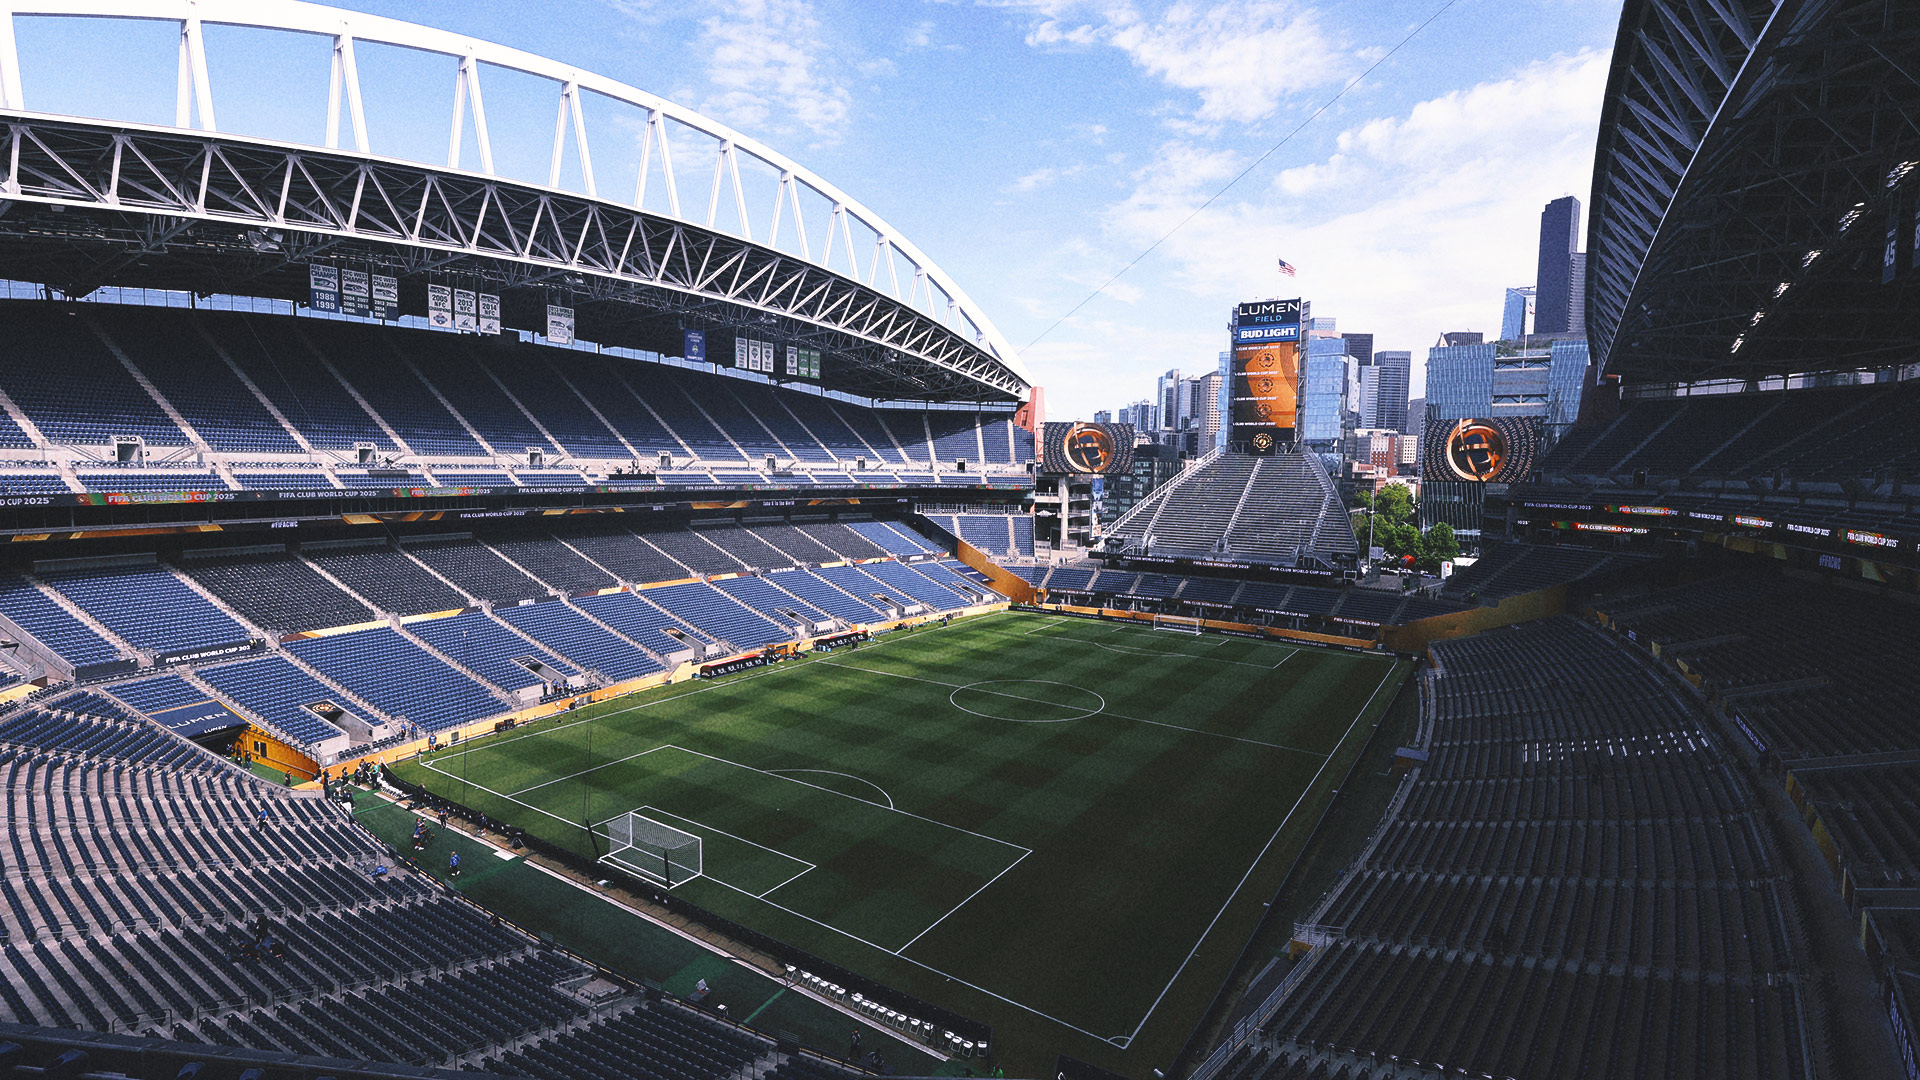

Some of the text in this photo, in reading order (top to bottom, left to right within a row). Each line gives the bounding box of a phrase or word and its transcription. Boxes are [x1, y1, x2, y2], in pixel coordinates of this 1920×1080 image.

[1884, 240, 1896, 266] 45
[310, 270, 337, 280] CHAMPS
[343, 276, 368, 285] CHAMPS
[374, 281, 396, 289] CHAMPS
[315, 292, 335, 301] 1988
[432, 294, 447, 302] 2005
[316, 300, 335, 310] 1999
[1239, 302, 1300, 316] LUMEN
[1255, 315, 1282, 323] FIELD
[1241, 328, 1296, 339] BUD LIGHT
[1802, 525, 1813, 534] WORLD
[1864, 535, 1877, 544] WORLD
[200, 650, 224, 658] WORLD
[167, 711, 228, 729] LUMEN
[204, 725, 227, 734] LUMEN
